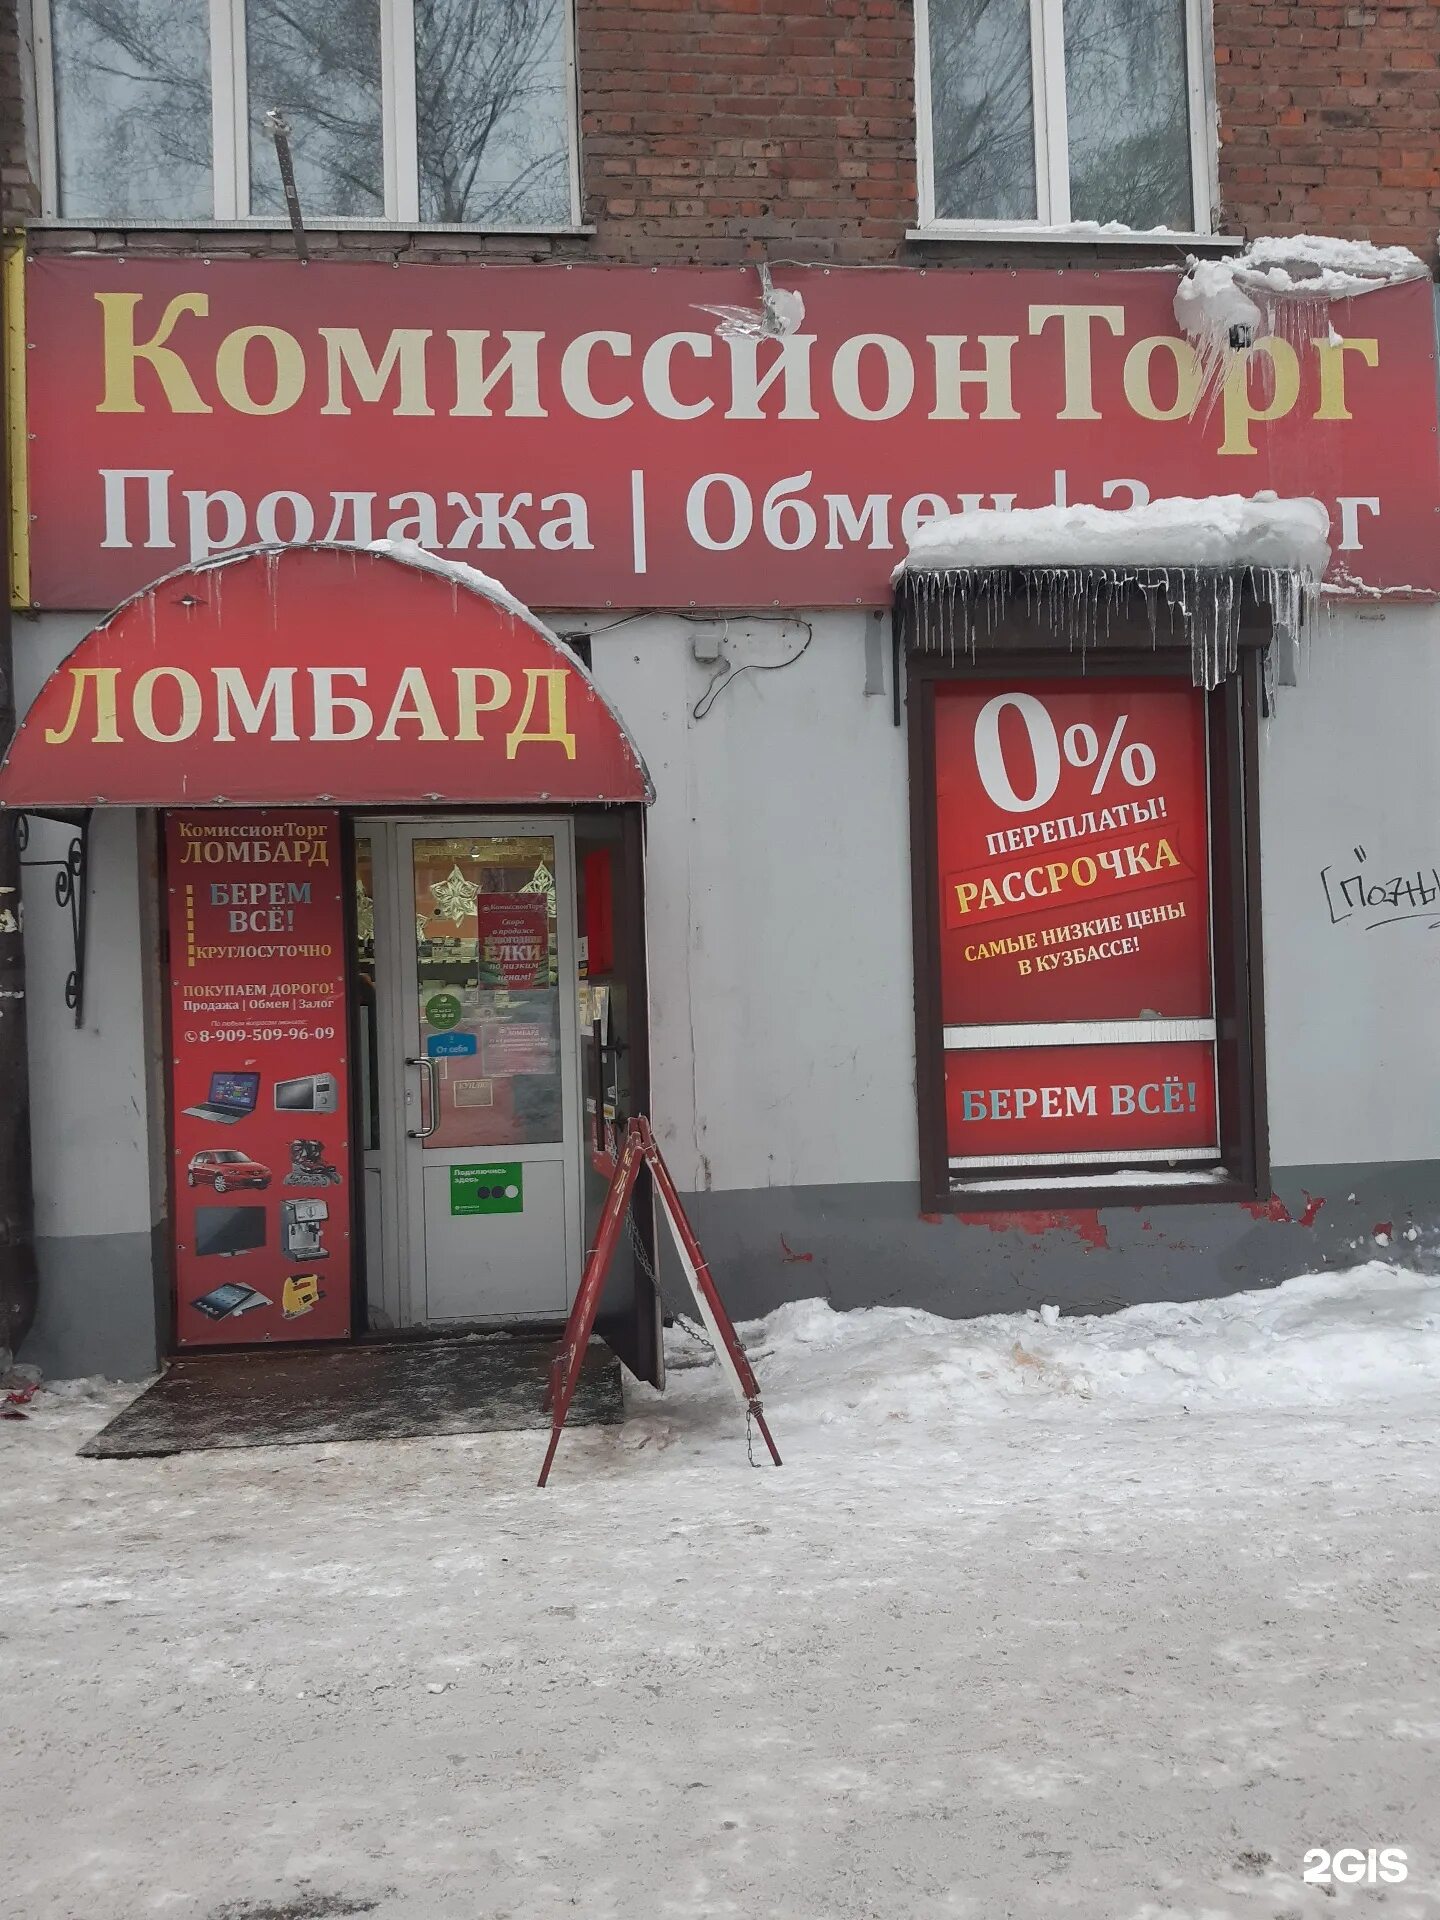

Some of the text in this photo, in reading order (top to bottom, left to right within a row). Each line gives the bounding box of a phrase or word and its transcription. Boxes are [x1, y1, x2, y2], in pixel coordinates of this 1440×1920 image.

[94, 293, 1379, 455] КомиссионТорг
[98, 470, 594, 563] Продажа
[45, 667, 577, 760] ЛОМБАРД
[974, 692, 1157, 813] 0%
[179, 822, 328, 838] КомиссионТорг
[985, 796, 1168, 856] ПЕРЕПЛАТЫ!
[180, 840, 329, 867] ЛОМБАРД
[210, 882, 312, 906] БЕРЕМ
[954, 838, 1181, 914] РАССРОЧКА
[229, 907, 294, 933] ВСЁ!
[964, 901, 1187, 962] САМЫЕ НИЗКИЕ ЦЕНЫ
[197, 944, 332, 959] КРУГЛОСУТОЧНО
[1017, 936, 1141, 976] В КУЗБАССЕ!
[184, 983, 335, 997] ПОКУПАЕМ ДОРОГО!
[184, 1001, 240, 1011] Продажа
[250, 1000, 290, 1009] Обмен
[299, 999, 335, 1009] Залог
[200, 1027, 335, 1042] 8-909-509-96-09
[962, 1076, 1197, 1122] БЕРЕМ ВСЁ!
